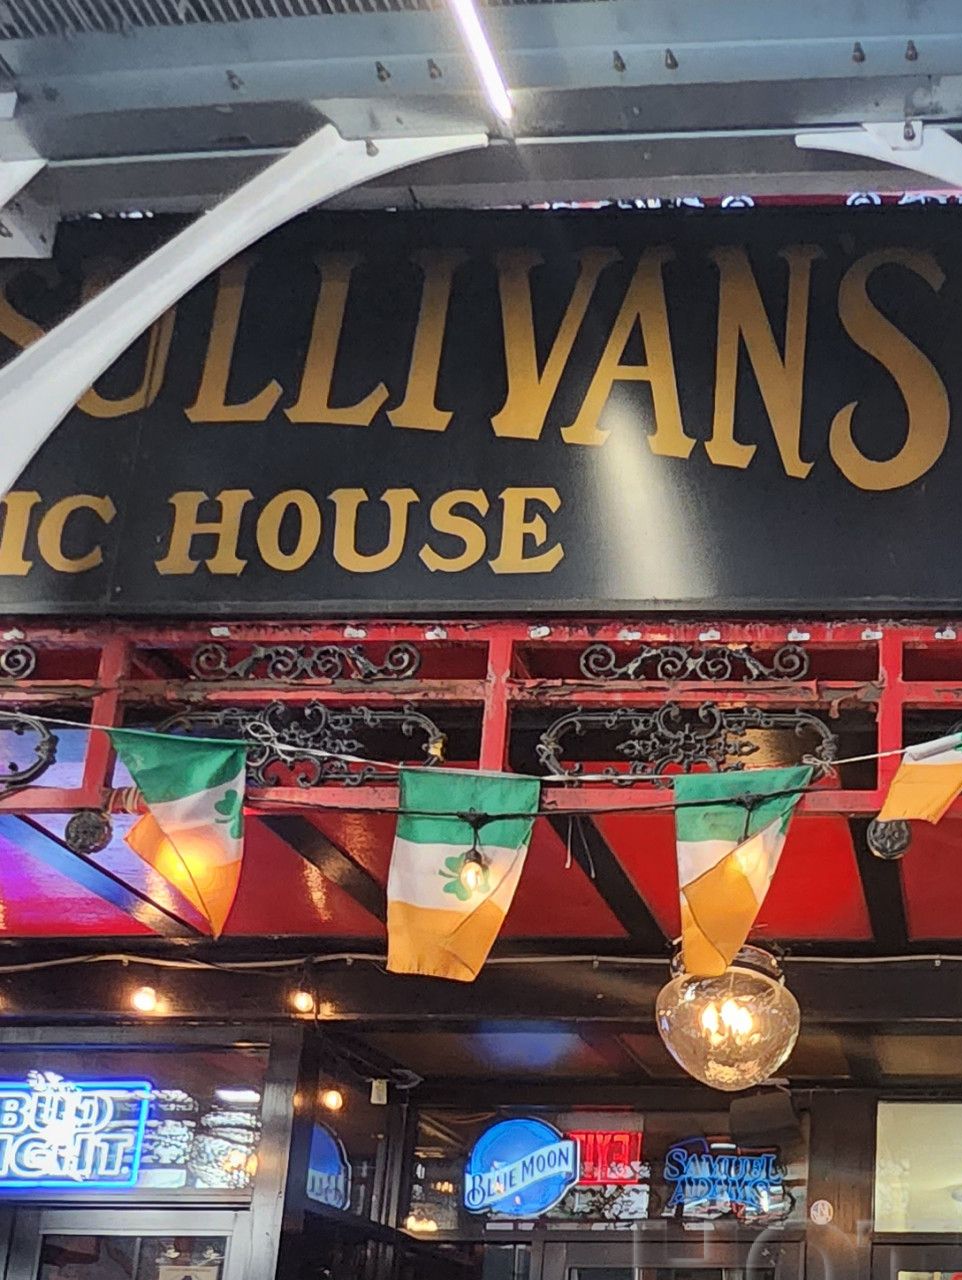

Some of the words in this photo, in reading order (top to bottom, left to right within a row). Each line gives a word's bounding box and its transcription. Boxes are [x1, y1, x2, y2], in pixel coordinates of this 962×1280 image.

[154, 487, 565, 575] HOUSE
[466, 1171, 517, 1208] BLUE
[521, 1146, 570, 1184] MOON
[664, 1148, 784, 1184] SAMUEL
